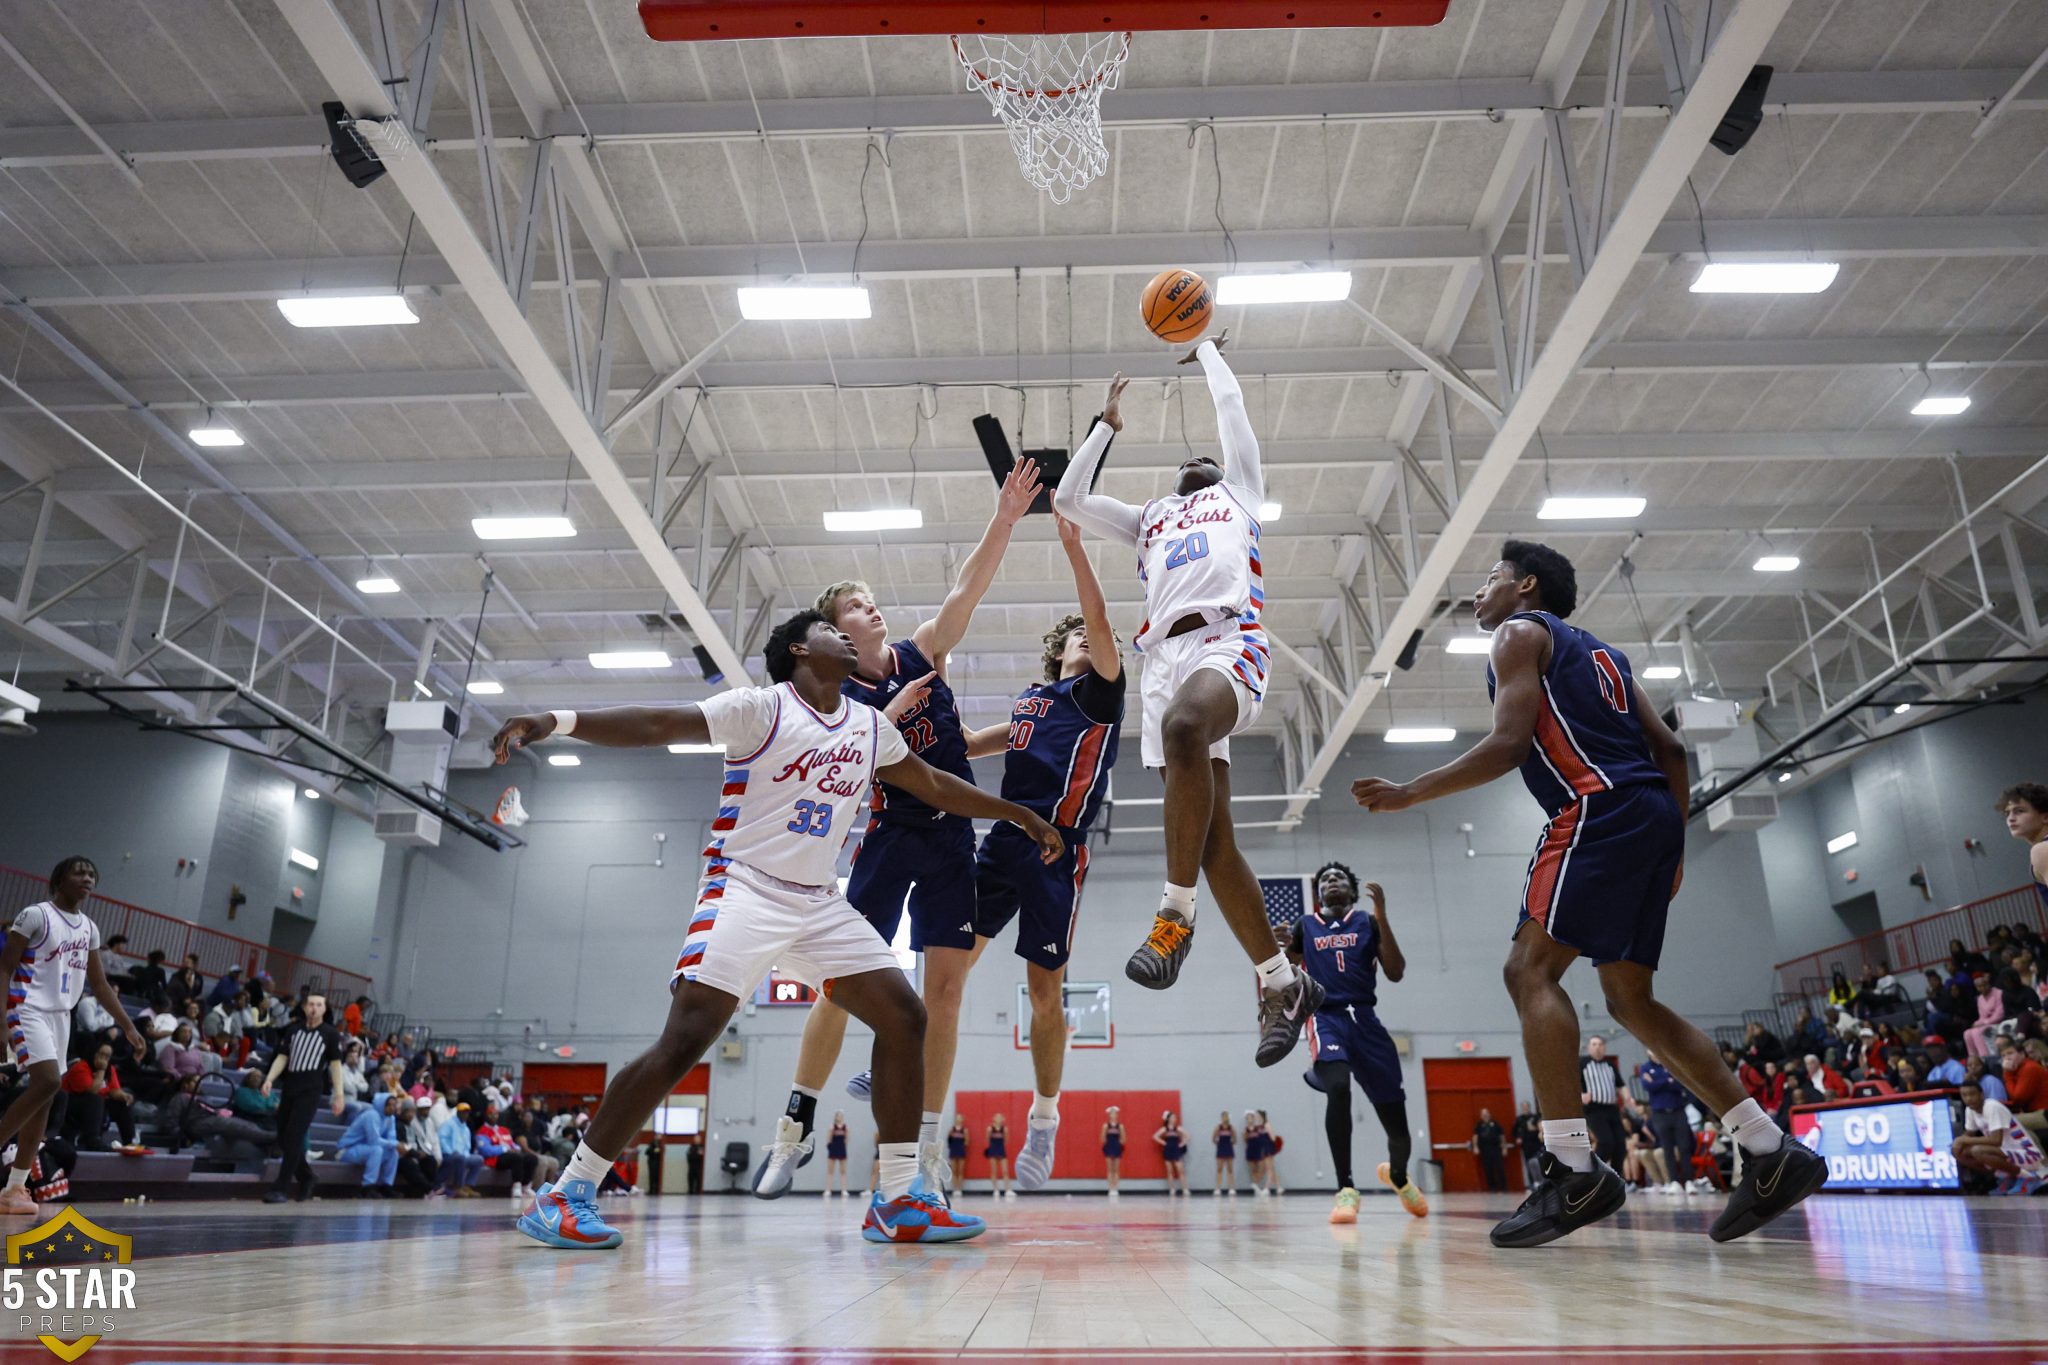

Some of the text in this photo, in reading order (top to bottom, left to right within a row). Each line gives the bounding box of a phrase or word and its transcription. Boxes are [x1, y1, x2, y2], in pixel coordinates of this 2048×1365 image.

[1166, 275, 1195, 302] NCAA
[1177, 508, 1233, 530] East
[1165, 531, 1209, 570] 20
[1012, 697, 1054, 718] EST
[903, 716, 939, 755] 22
[772, 741, 864, 783] Austin
[816, 764, 865, 797] East
[786, 798, 833, 838] 33
[1314, 933, 1358, 951] WEST
[1336, 950, 1345, 972] 1
[1844, 1112, 1891, 1147] GO
